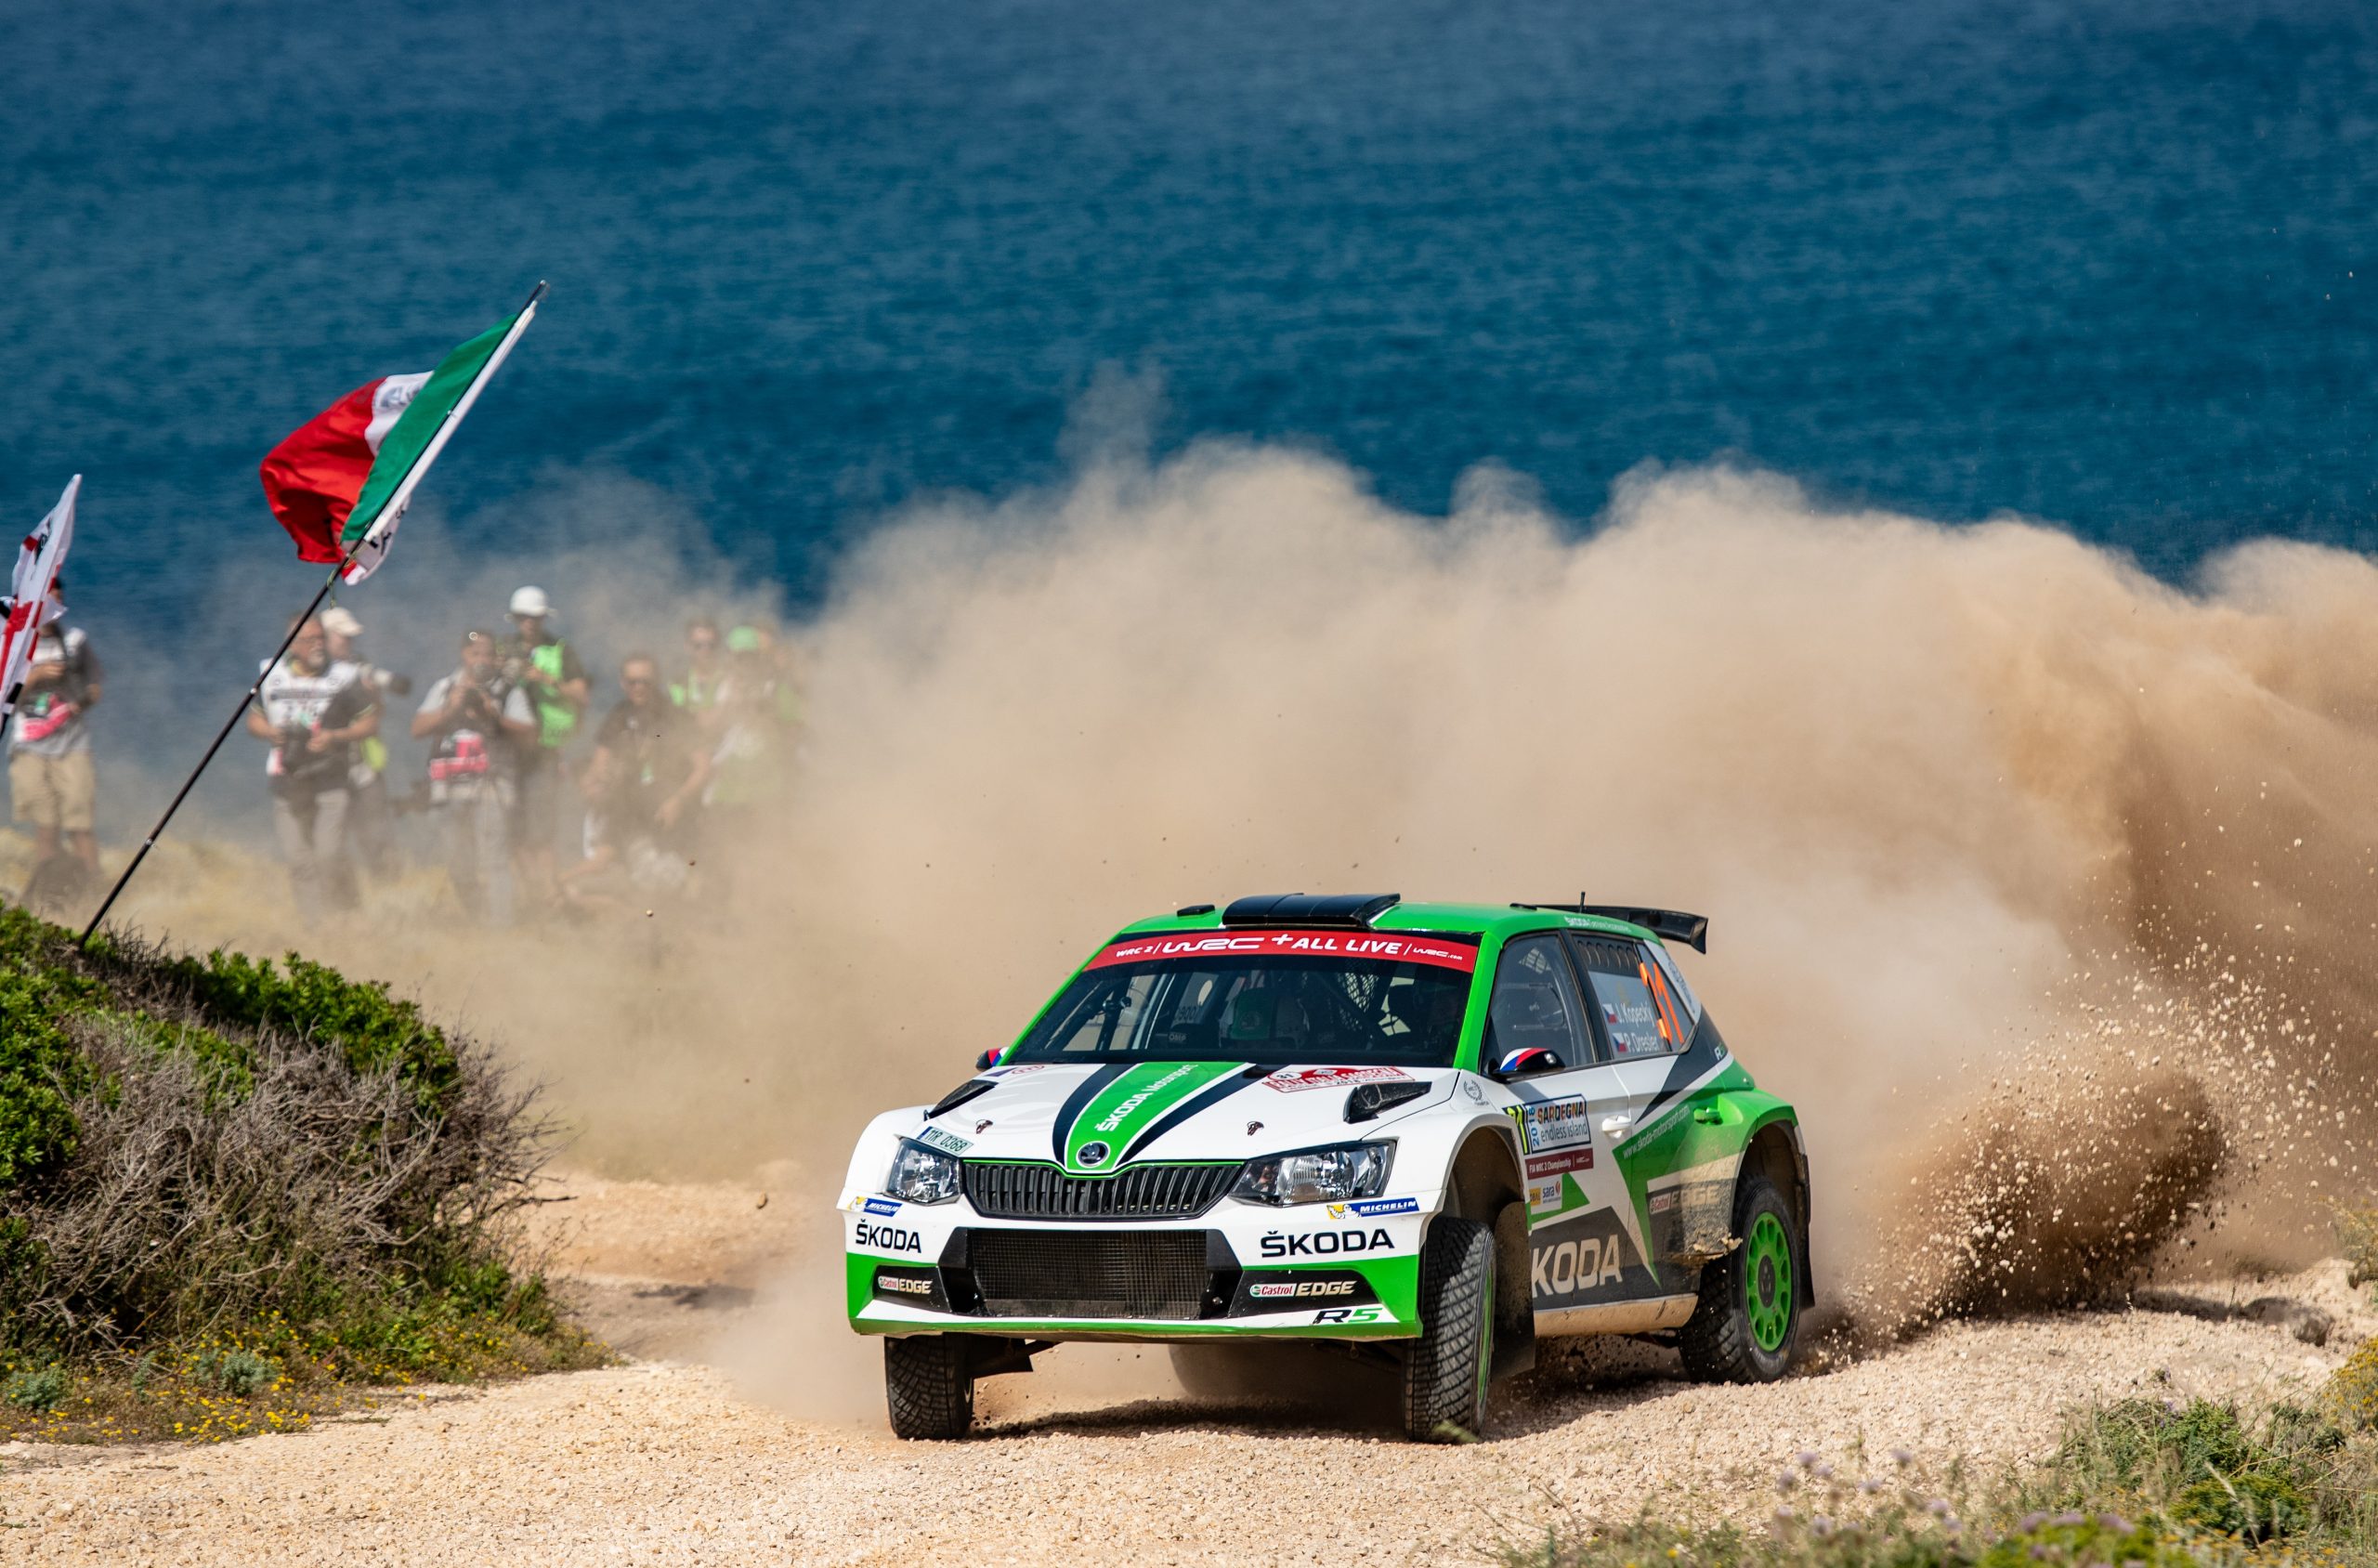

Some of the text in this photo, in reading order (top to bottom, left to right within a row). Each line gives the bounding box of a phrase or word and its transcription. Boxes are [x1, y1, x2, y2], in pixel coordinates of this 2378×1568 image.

[1116, 947, 1142, 958] WRC
[1345, 939, 1404, 956] LIVE
[1094, 1091, 1155, 1132] ŠKODA
[1537, 1101, 1585, 1125] SARDEGNA
[1528, 1107, 1540, 1147] 2018
[1540, 1120, 1588, 1143] endless island
[940, 1135, 968, 1152] 0368
[1542, 1185, 1555, 1198] sara
[868, 1202, 900, 1213] MICHELIN
[1360, 1200, 1417, 1213] MICHELIN
[856, 1218, 922, 1254] ŠKODA
[1260, 1228, 1396, 1259] ŠKODA
[1531, 1234, 1624, 1299] KODA
[898, 1278, 934, 1295] EDGE
[1261, 1280, 1358, 1298] Castrol EDGE
[1312, 1307, 1383, 1326] R5
